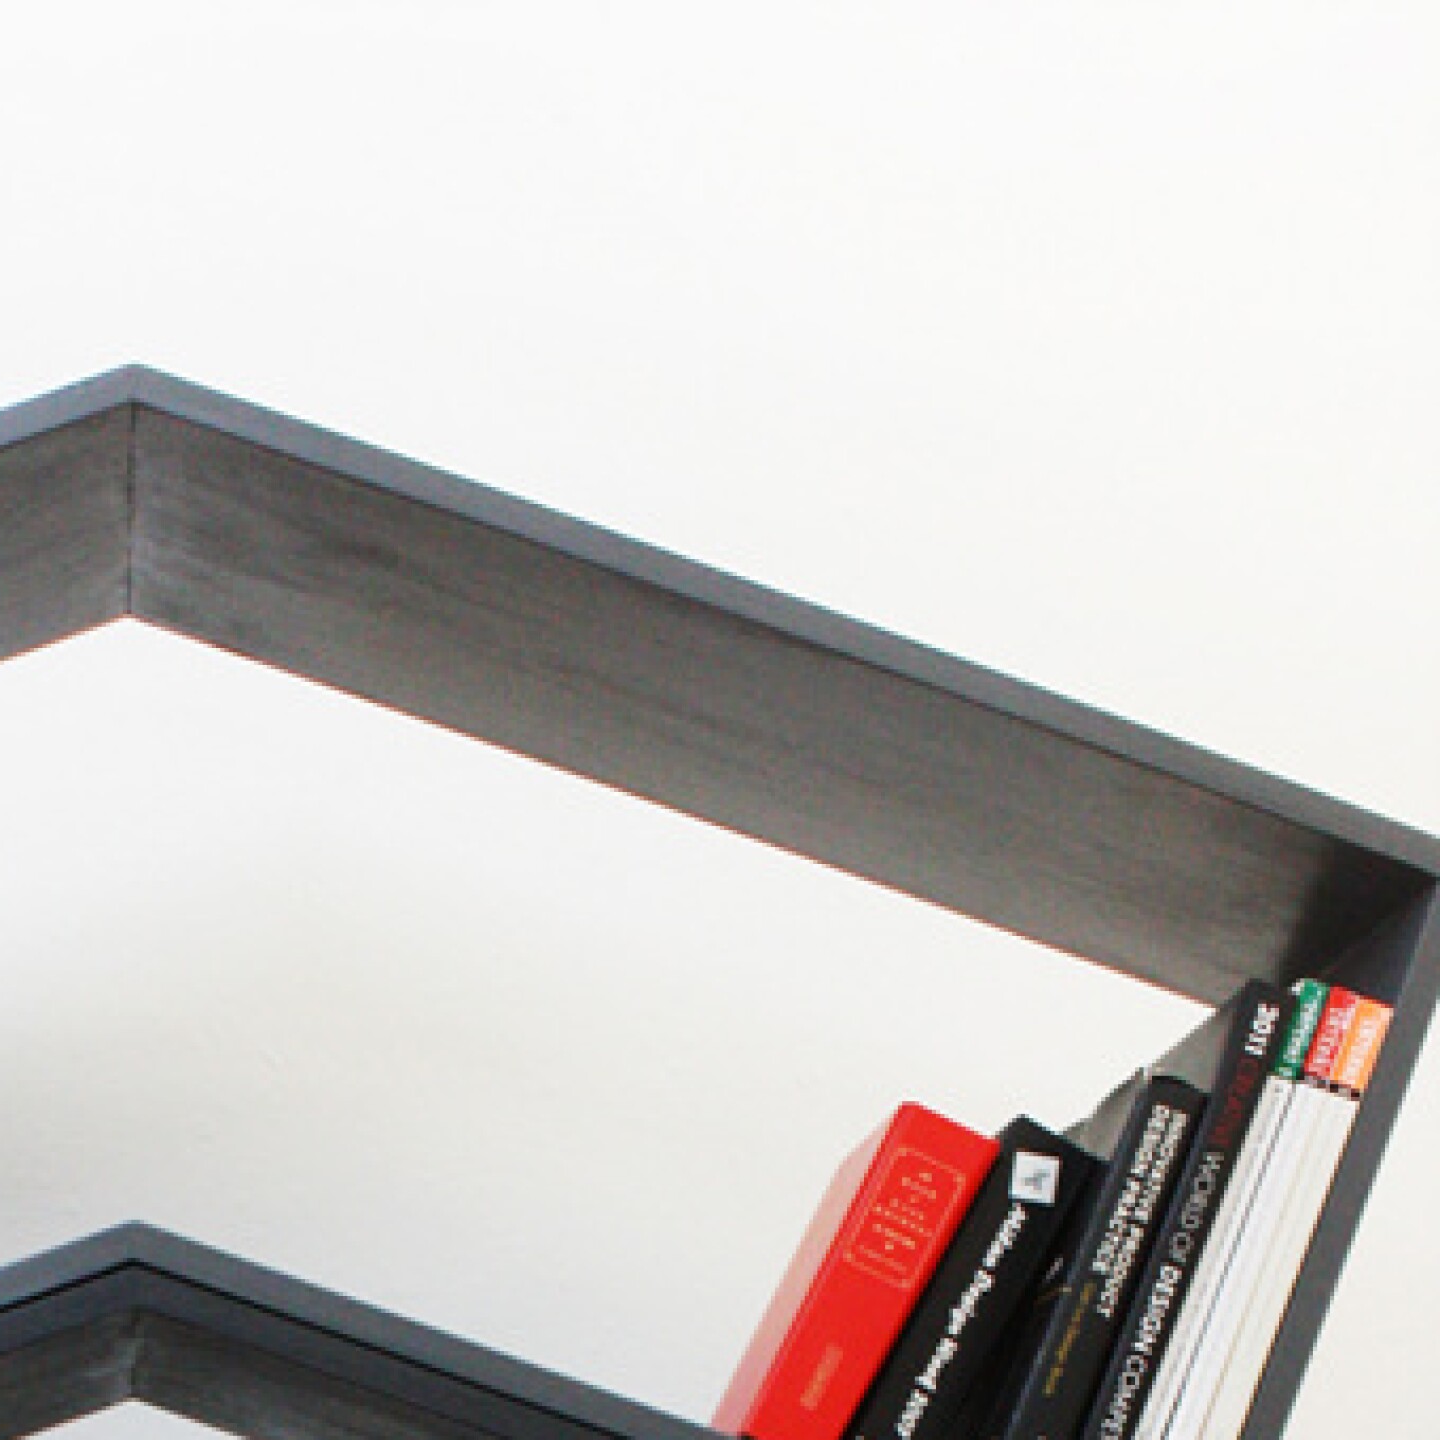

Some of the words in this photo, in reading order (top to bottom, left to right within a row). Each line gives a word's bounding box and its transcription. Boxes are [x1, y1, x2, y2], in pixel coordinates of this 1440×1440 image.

[1245, 1004, 1277, 1057] 2011
[1091, 1179, 1137, 1272] PRACTICE
[1180, 1150, 1221, 1228] WORLD
[1096, 1225, 1140, 1315] PRODUCT
[1166, 1229, 1192, 1263] OF
[1132, 1264, 1179, 1353] DESIGN
